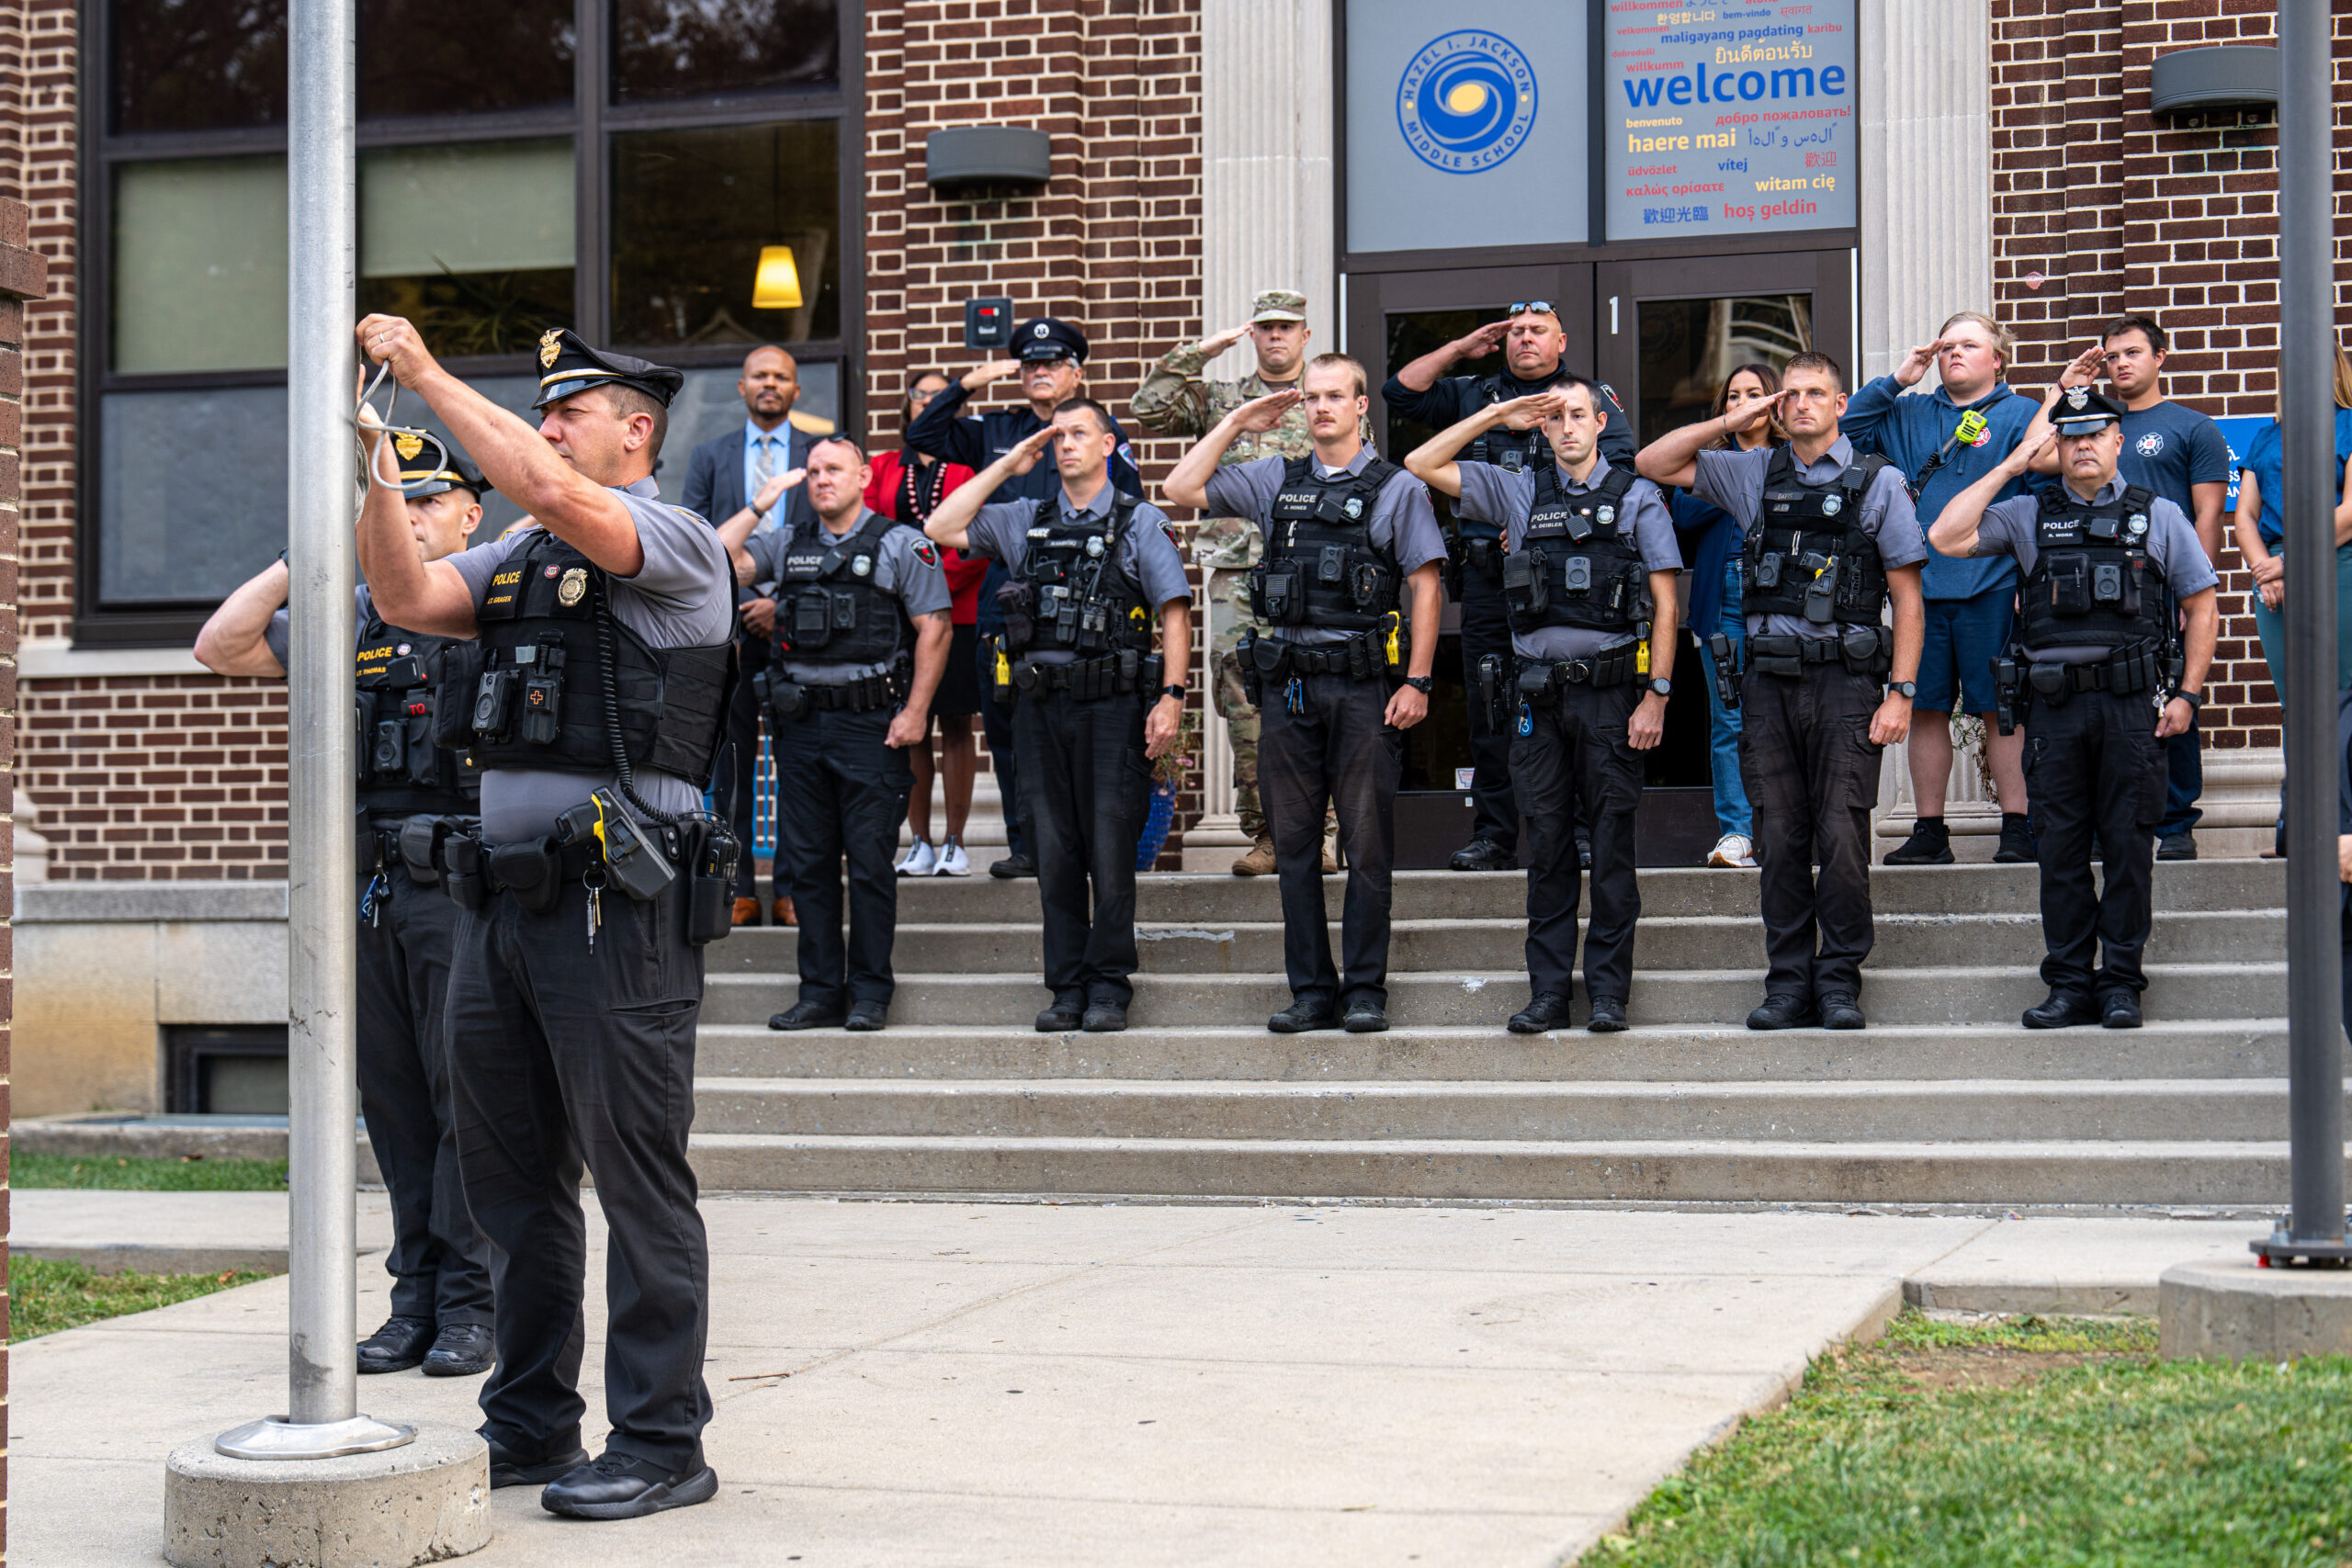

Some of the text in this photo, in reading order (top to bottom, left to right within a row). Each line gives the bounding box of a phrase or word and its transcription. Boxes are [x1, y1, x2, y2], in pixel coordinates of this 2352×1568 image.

[1611, 0, 1683, 13] willkommen
[1723, 8, 1771, 20] bem-vindo
[1657, 10, 1716, 26] 환영합니다
[1617, 26, 1669, 35] velkommen
[1661, 24, 1804, 45] maligayang pagdating
[1807, 23, 1842, 34] karibu
[1404, 36, 1531, 100] HAZEL I. JACKSON
[1625, 61, 1684, 73] willkumm
[1623, 62, 1846, 107] welcome
[1626, 117, 1683, 129] benvenuto
[1715, 106, 1851, 127] добро пожаловать!
[1407, 114, 1529, 167] MIDDLE SCHOOL
[1628, 128, 1736, 152] haere mai
[1628, 164, 1677, 176] üdvözlet
[1717, 158, 1747, 173] vítej
[1626, 181, 1724, 197] καλώς ορίσατε
[1755, 174, 1836, 192] witam cię
[1644, 206, 1709, 224] 歡迎光臨
[1724, 199, 1817, 222] hoş geldin
[1610, 296, 1618, 334] 1
[1279, 494, 1317, 503] POLICE
[1531, 512, 1568, 523] POLICE
[2043, 520, 2080, 530] POLICE
[492, 570, 522, 586] POLICE
[356, 647, 393, 661] POLICE
[363, 667, 386, 675] THOMAS
[1521, 718, 1530, 733] 3
